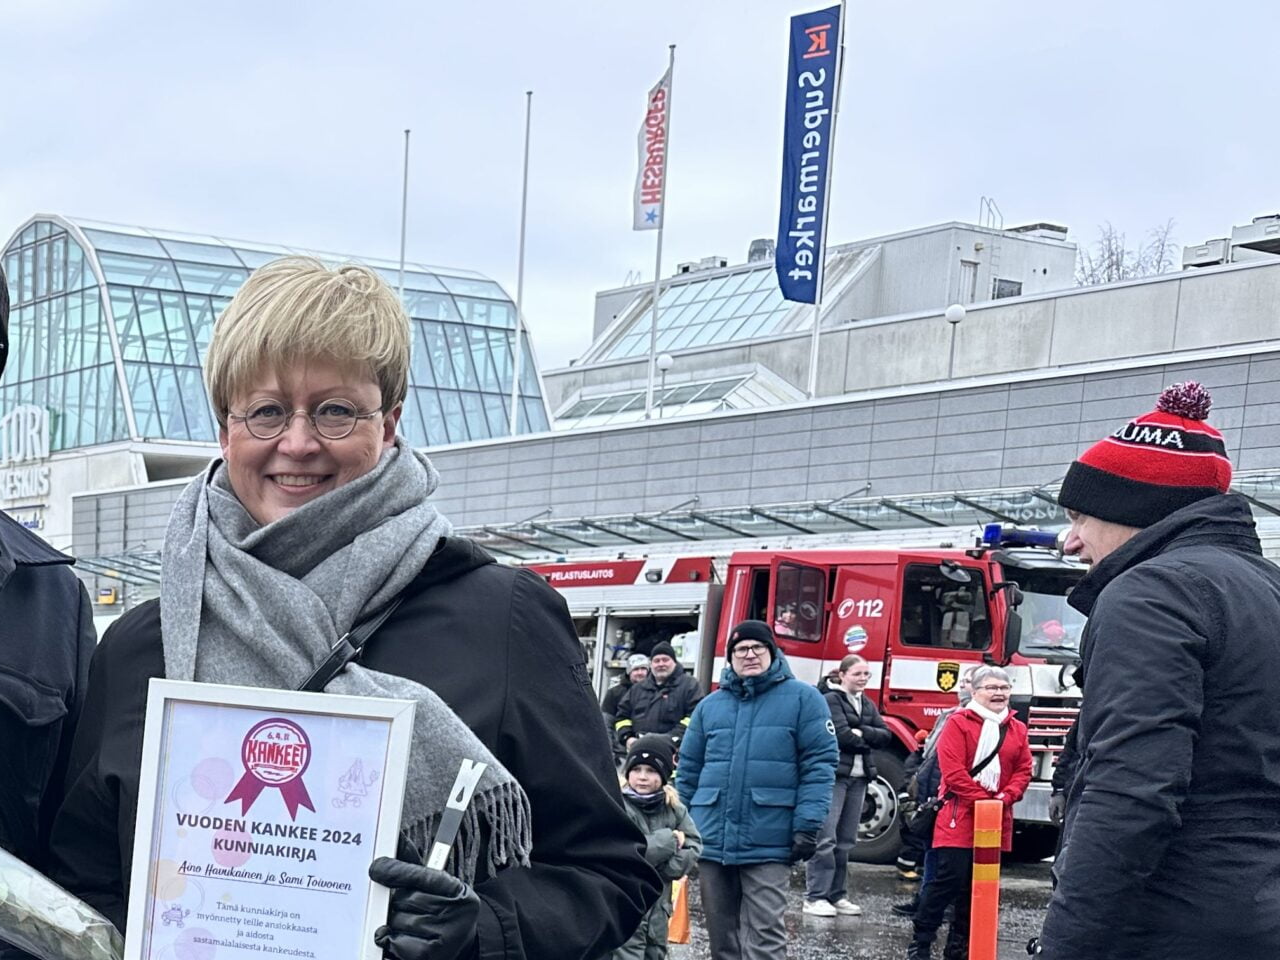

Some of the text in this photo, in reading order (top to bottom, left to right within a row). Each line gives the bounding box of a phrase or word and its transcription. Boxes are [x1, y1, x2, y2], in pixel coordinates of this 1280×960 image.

[1, 404, 50, 467] TORI
[0, 467, 51, 500] KESKUS
[551, 569, 615, 581] PELASTUSLAITOS
[856, 599, 884, 617] 112
[923, 707, 942, 717] VIHA
[246, 739, 307, 767] KANKEET
[176, 812, 362, 846] VUODEN KANKEE 2024
[213, 838, 318, 863] KUNNIAKIRJA
[178, 860, 353, 892] Aino Havukainen ja Sami Toivonen
[216, 901, 300, 920] Tämä kunniakirja on
[197, 912, 318, 935] myönnetty teille ansiokkaasta
[236, 929, 275, 941] ja aidosta
[193, 936, 261, 951] sastamalalaisesta
